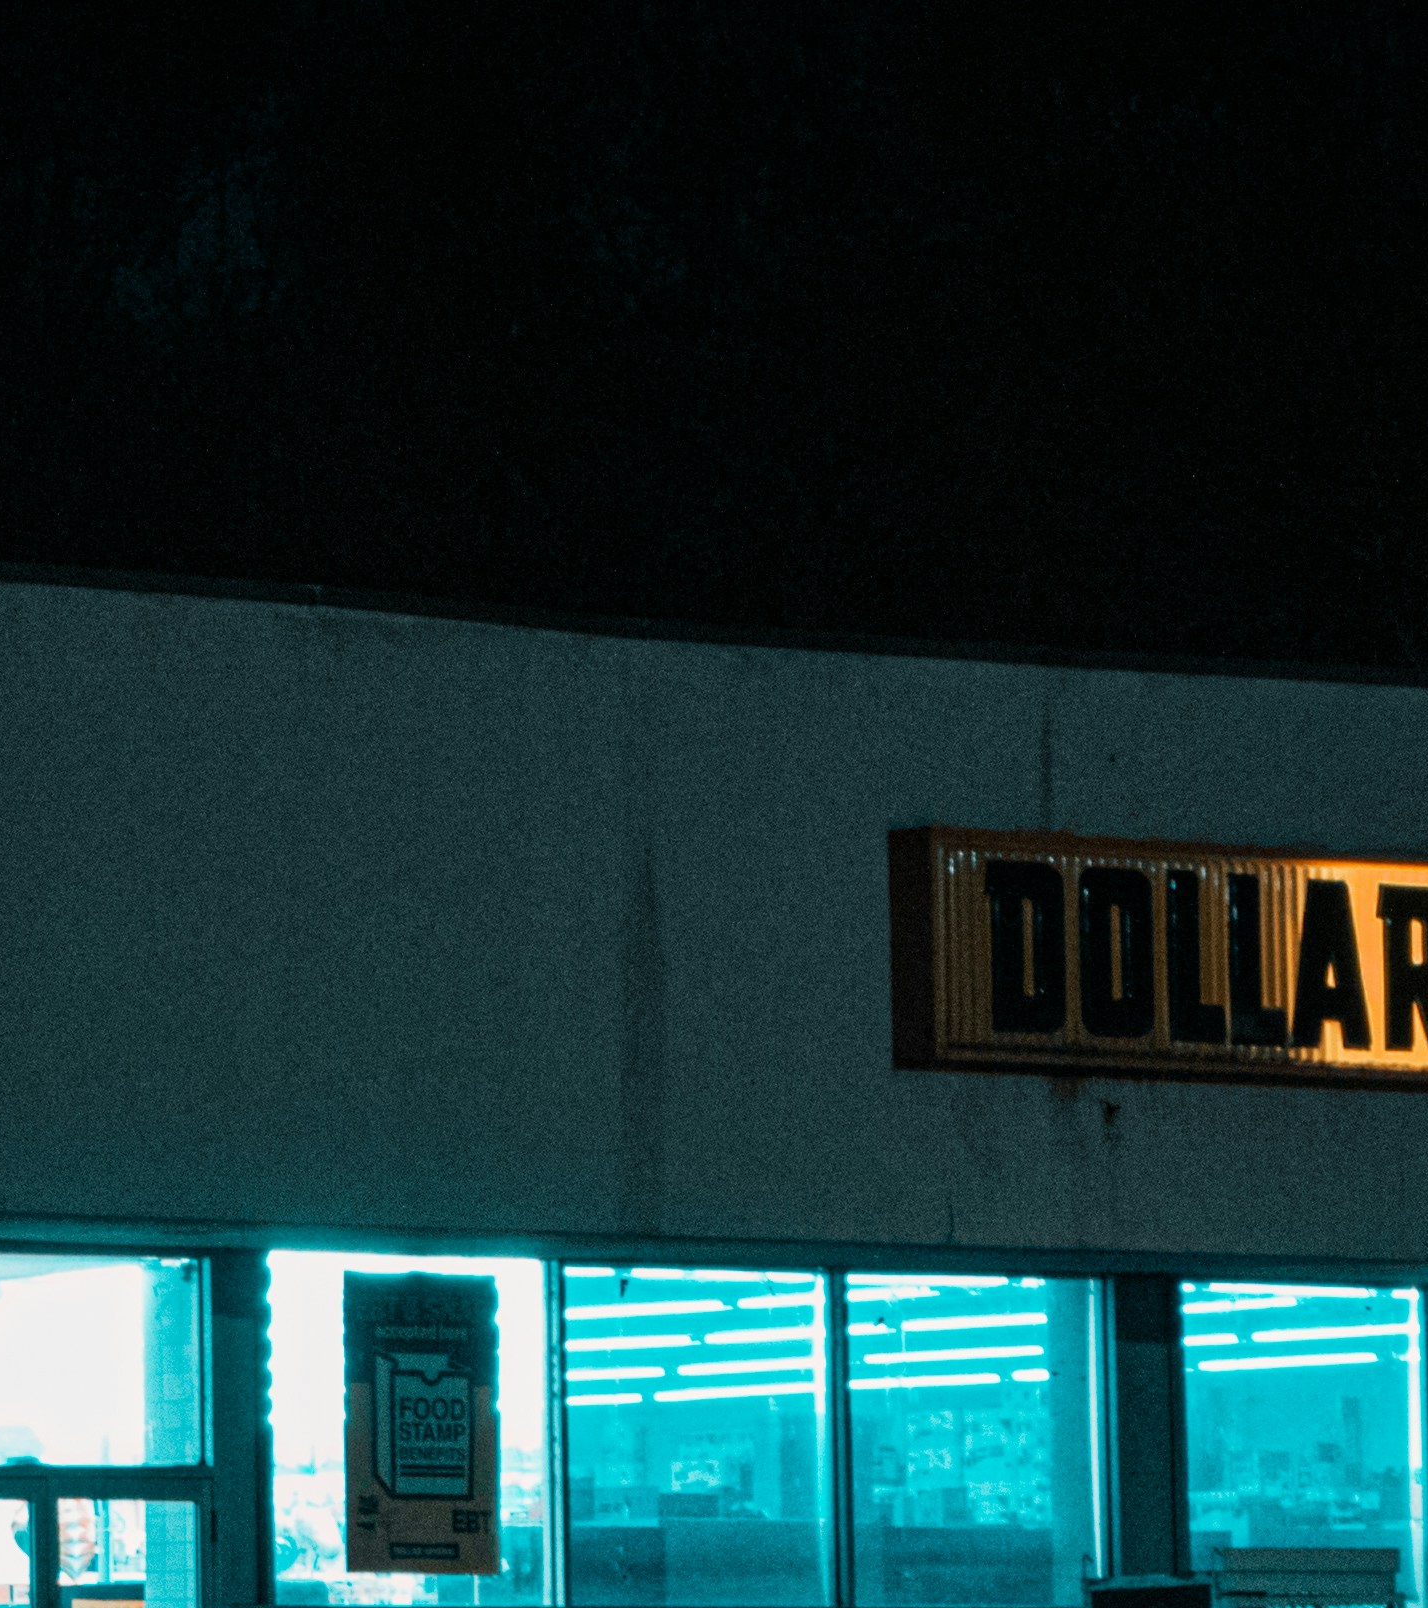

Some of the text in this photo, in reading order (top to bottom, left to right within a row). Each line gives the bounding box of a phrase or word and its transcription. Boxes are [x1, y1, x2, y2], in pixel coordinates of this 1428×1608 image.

[399, 1397, 466, 1420] FOOD
[399, 1421, 467, 1442] STAMP
[452, 1510, 492, 1534] EBT
